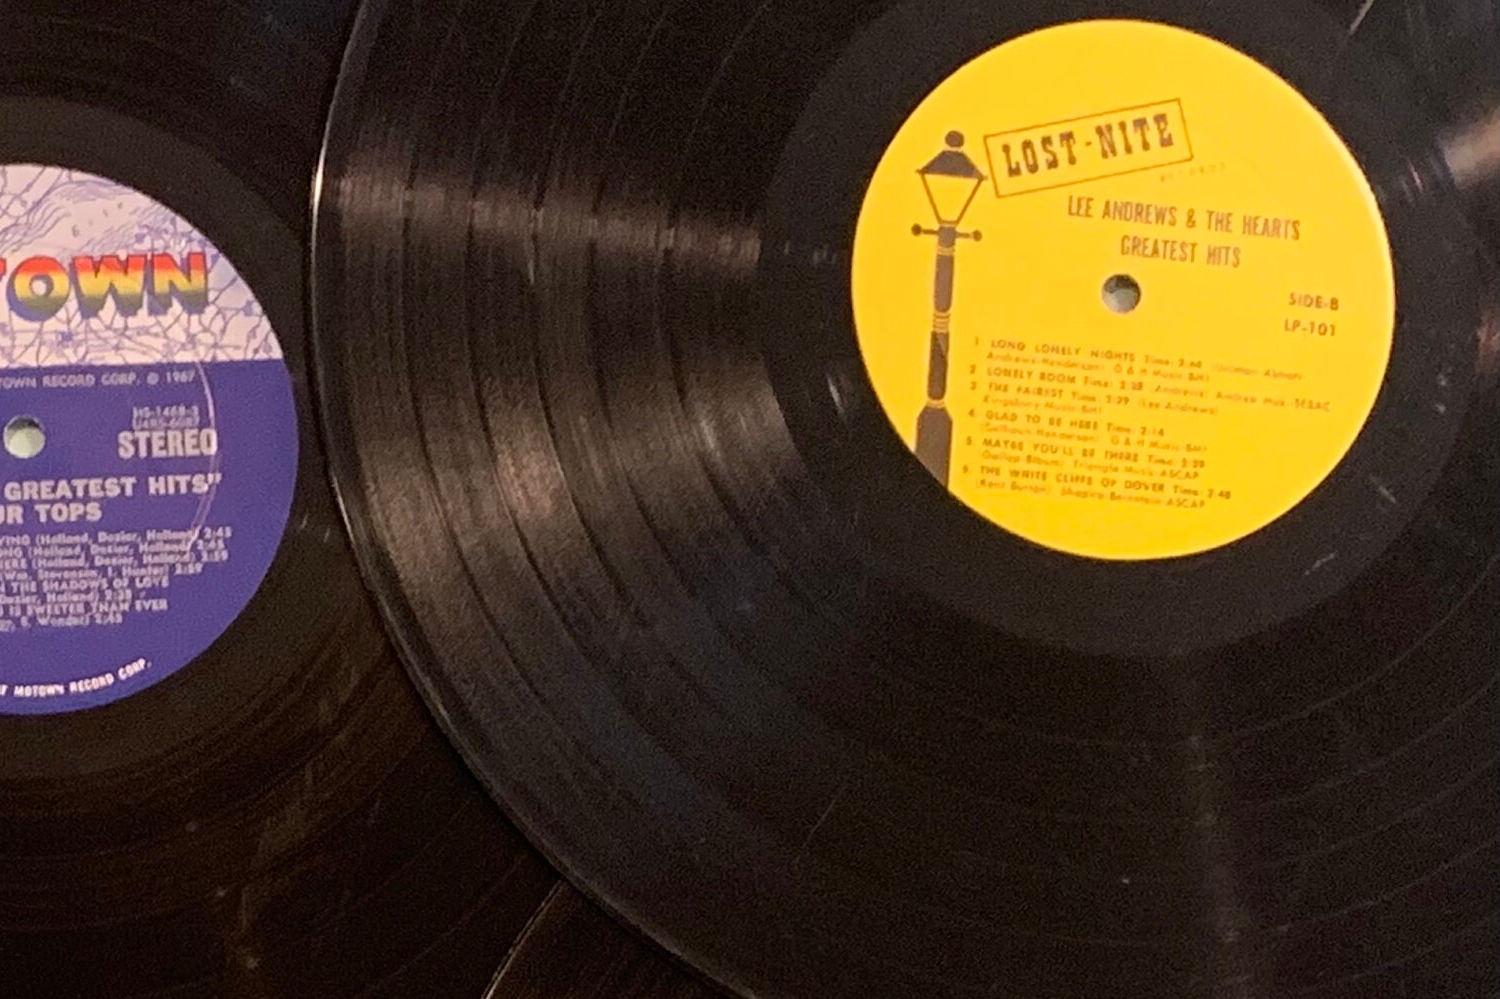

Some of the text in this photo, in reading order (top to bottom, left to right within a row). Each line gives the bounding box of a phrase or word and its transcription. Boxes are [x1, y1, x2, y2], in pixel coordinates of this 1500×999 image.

[1067, 194, 1301, 241] LEE ANDREWS & THE HEARTS
[1119, 234, 1242, 268] GREATEST HITS
[42, 373, 96, 389] RECORD
[116, 428, 219, 460] STEREO
[4, 476, 137, 501] GREATEST
[34, 502, 103, 523] TOPS
[13, 682, 65, 698] MOTOWN
[69, 673, 115, 694] RECORD
